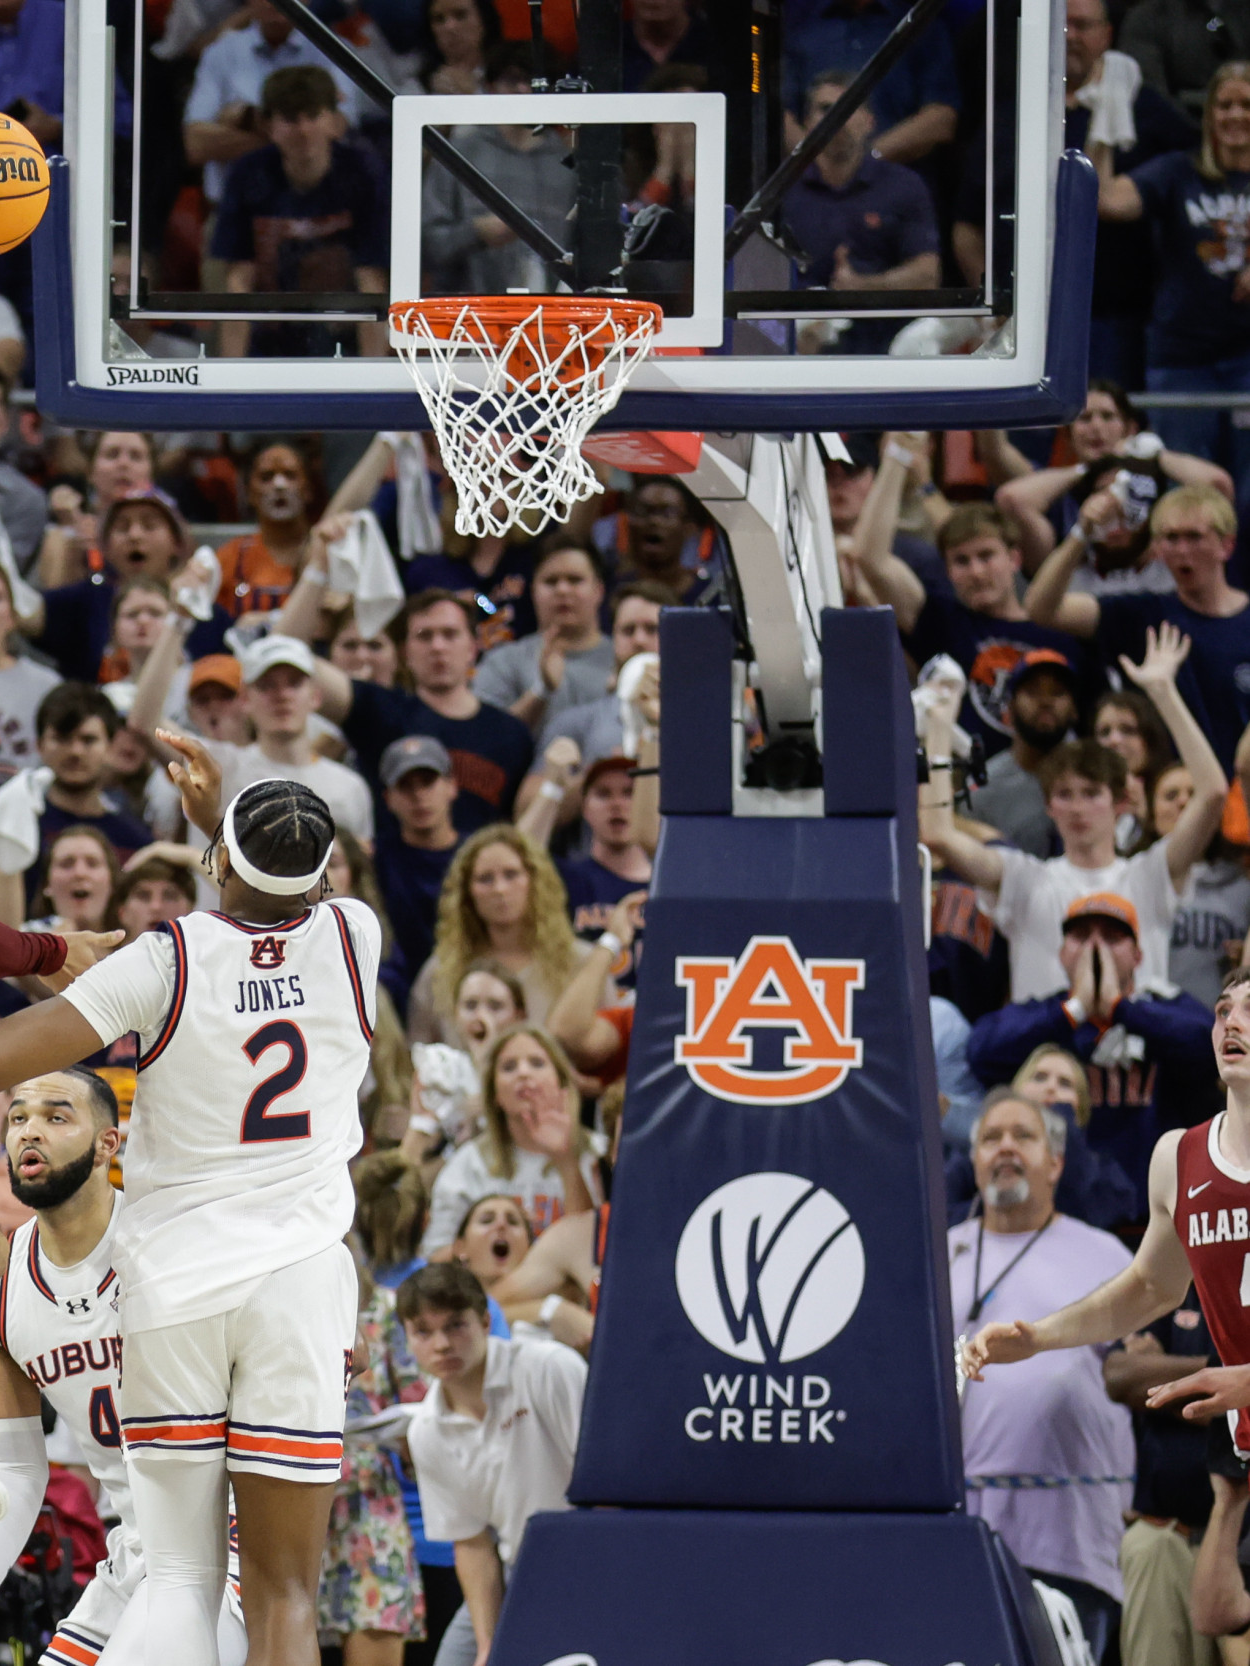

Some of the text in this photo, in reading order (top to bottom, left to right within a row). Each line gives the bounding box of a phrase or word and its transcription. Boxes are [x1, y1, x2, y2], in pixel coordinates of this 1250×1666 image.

[106, 365, 198, 387] SPALDING
[235, 974, 305, 1014] JONES
[674, 935, 866, 1105] AU
[240, 1018, 312, 1145] 2
[1188, 1207, 1250, 1248] ALAB
[25, 1335, 123, 1389] AUBUR
[703, 1373, 832, 1408] WIND
[684, 1406, 838, 1444] CREEK
